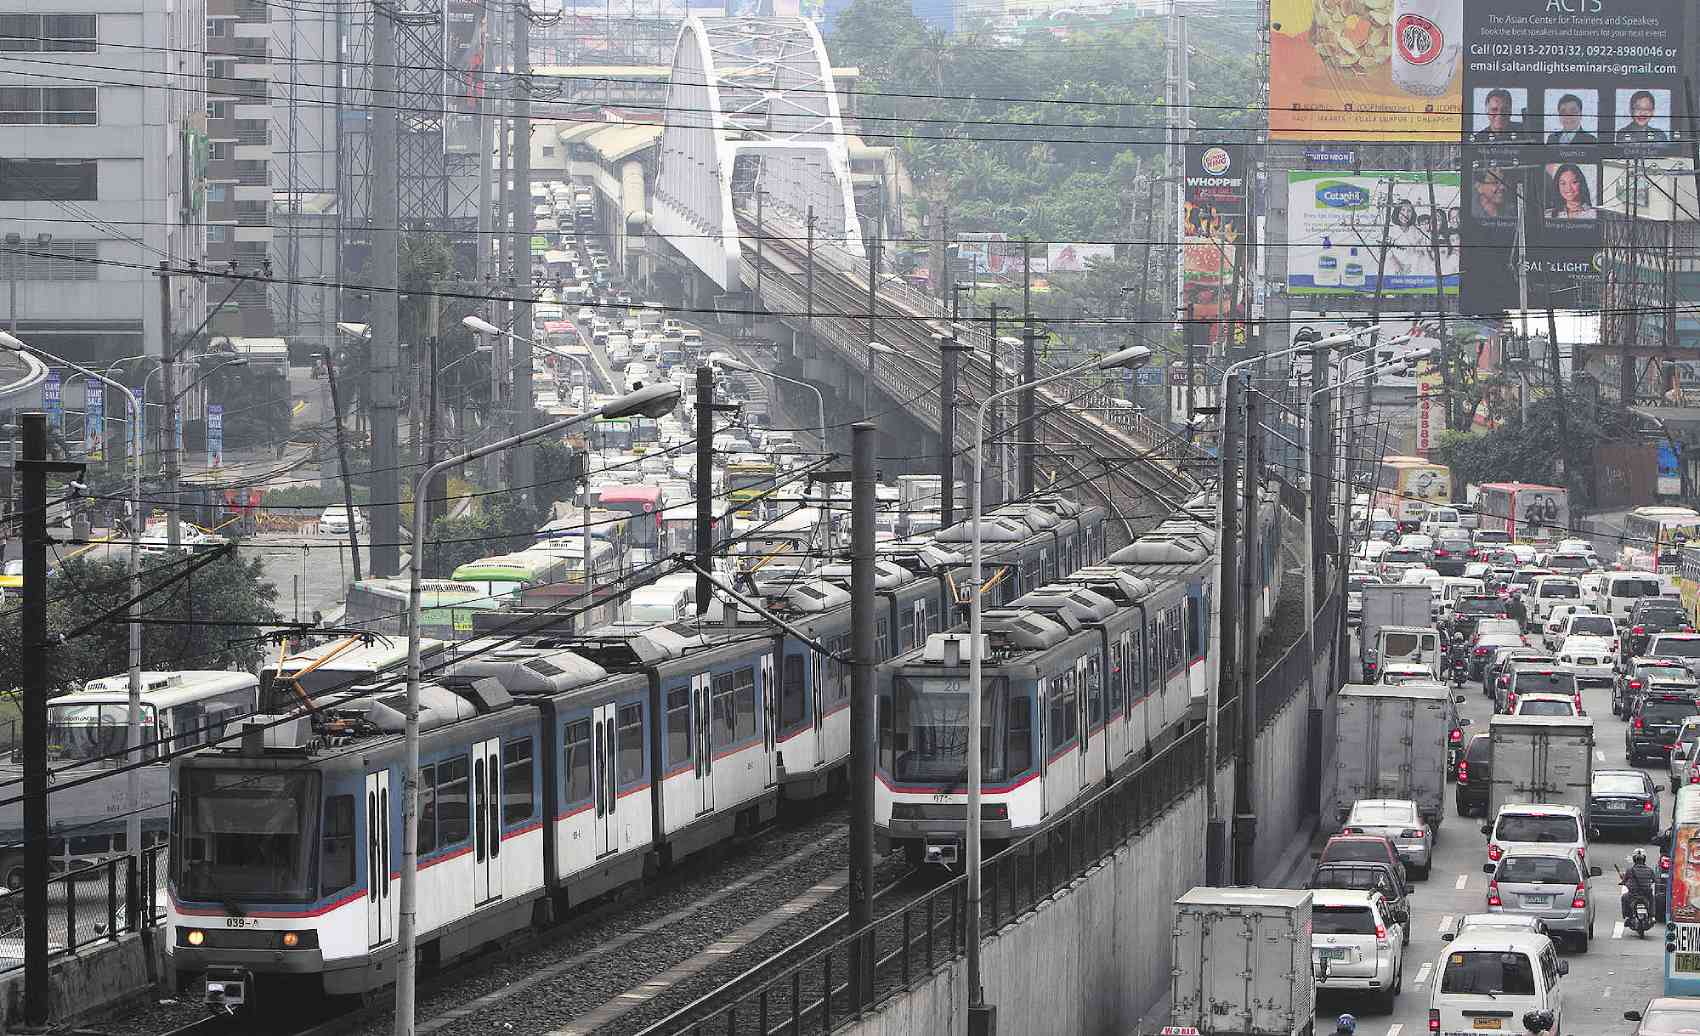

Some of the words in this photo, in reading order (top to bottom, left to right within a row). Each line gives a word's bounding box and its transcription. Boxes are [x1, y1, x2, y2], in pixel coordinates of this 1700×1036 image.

[1488, 14, 1503, 24] The
[1505, 14, 1528, 24] Asian
[1529, 14, 1556, 24] Center
[1558, 15, 1570, 24] for
[1572, 15, 1603, 24] Trainers
[1604, 15, 1620, 24] and
[1622, 15, 1659, 26] Speakers
[1470, 43, 1490, 55] Call
[1492, 43, 1513, 57] (02)
[1514, 44, 1584, 57] 813-2703/32,
[1586, 46, 1663, 57] 0922-8980046
[1665, 48, 1677, 57] or
[1470, 60, 1499, 71] email
[1501, 60, 1677, 75] saltandlightseminars@gmail.com
[943, 679, 960, 691] 20
